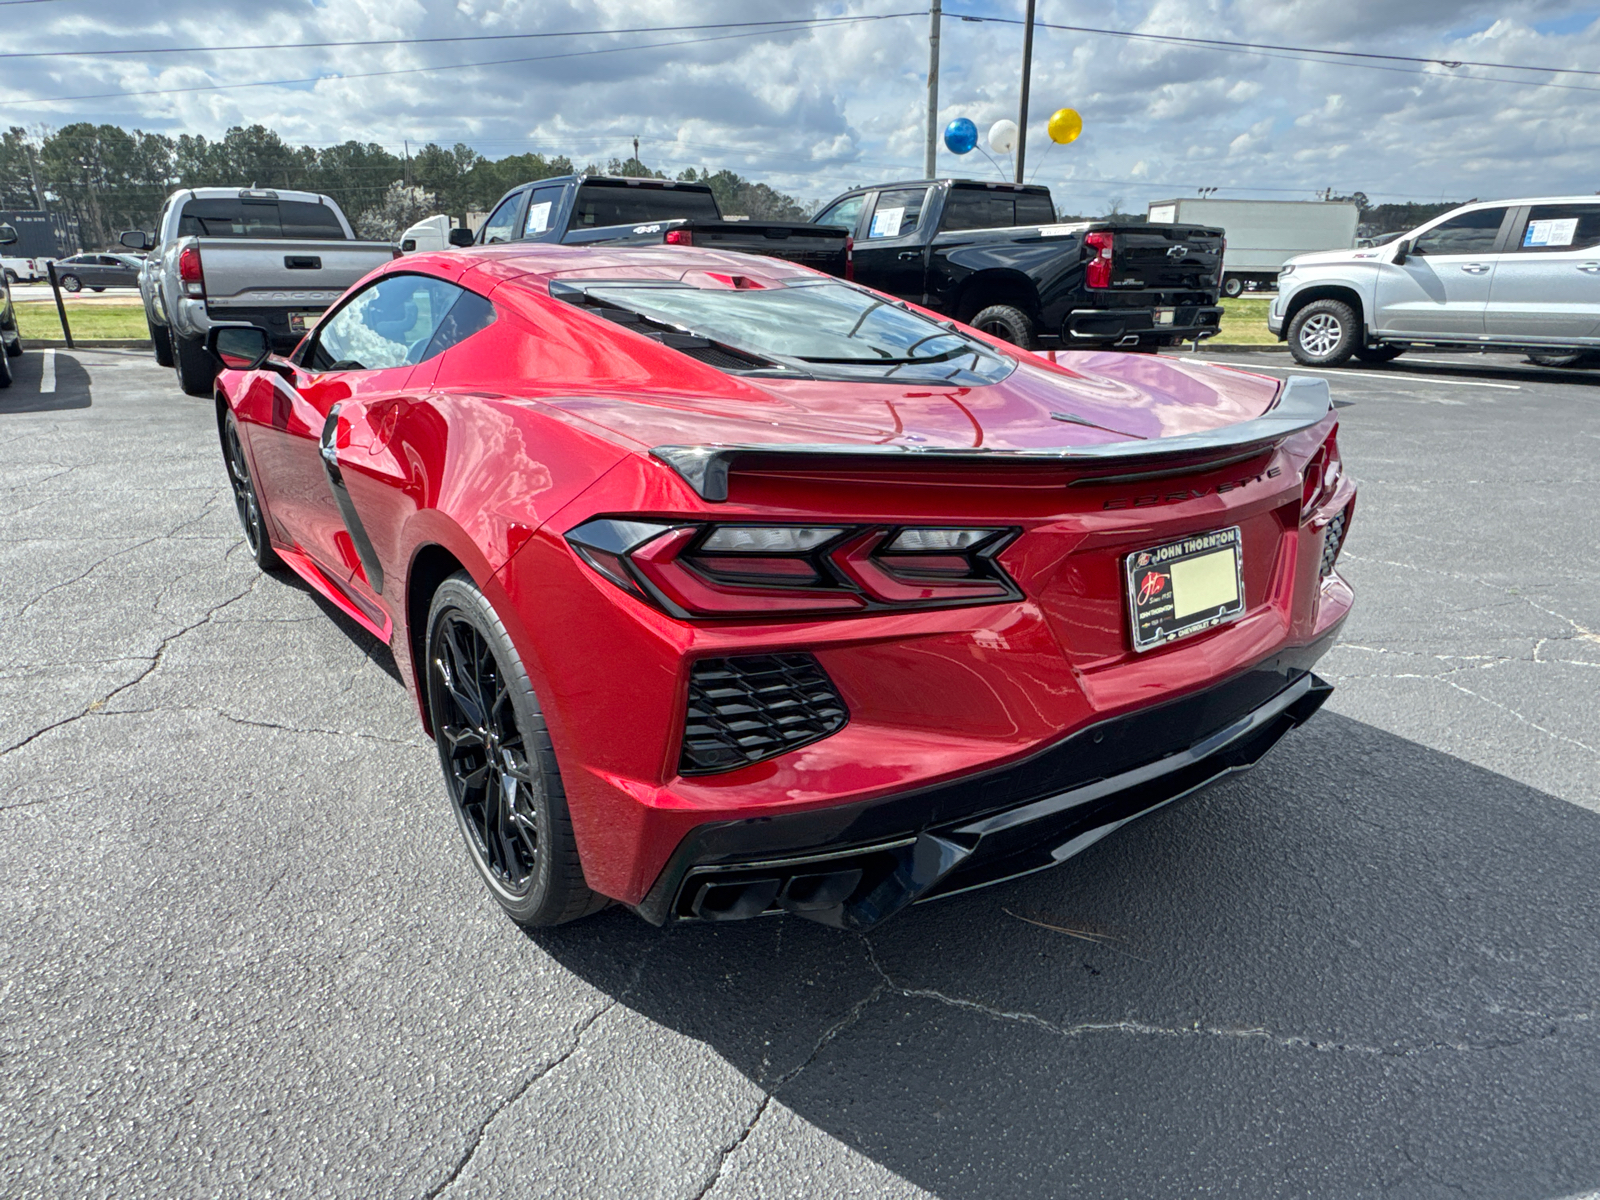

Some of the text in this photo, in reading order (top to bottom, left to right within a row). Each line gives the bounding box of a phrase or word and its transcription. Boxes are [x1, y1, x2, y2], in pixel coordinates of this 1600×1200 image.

[251, 292, 343, 301] TACOM
[1103, 466, 1282, 511] CORVETTE
[1155, 543, 1183, 562] JOHN
[1184, 530, 1235, 554] THORNTON
[1178, 621, 1210, 637] CHEVROLET
